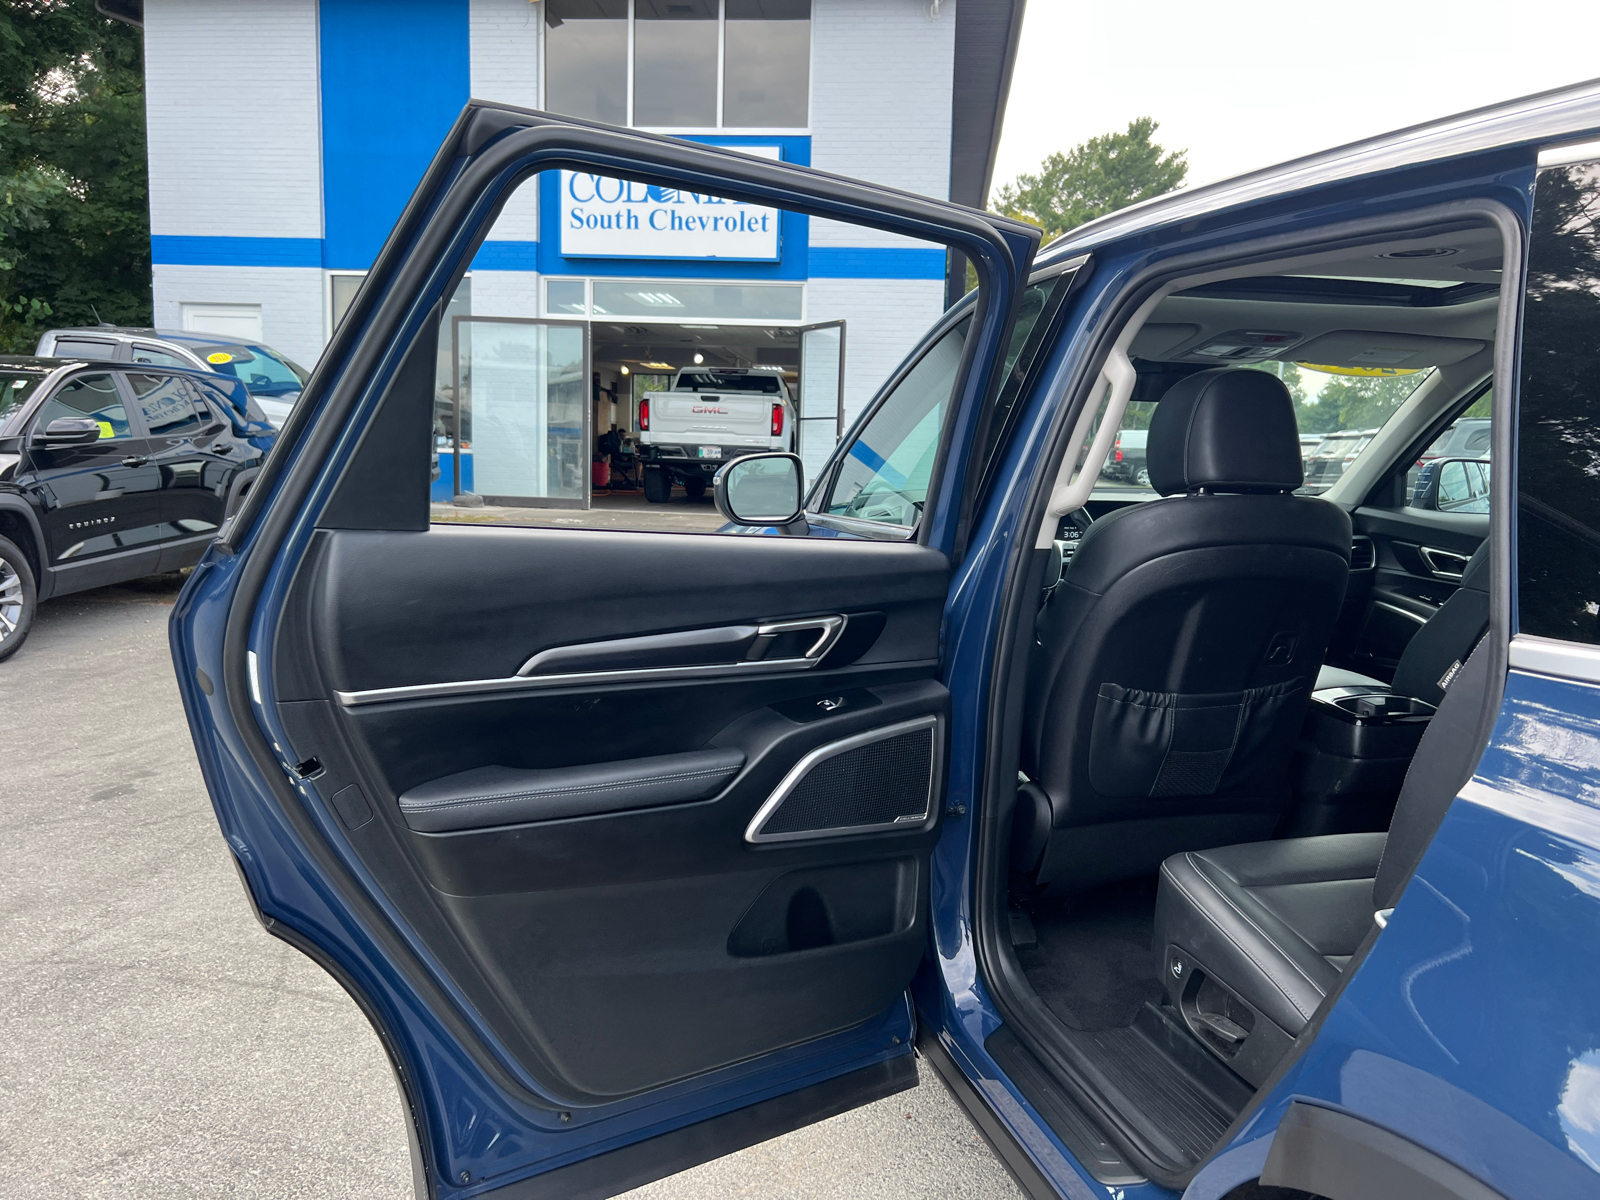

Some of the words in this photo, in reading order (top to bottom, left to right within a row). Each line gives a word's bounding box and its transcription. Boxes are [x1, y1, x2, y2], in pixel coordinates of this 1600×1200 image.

[570, 207, 640, 230] South
[649, 208, 770, 233] Chevrolet
[692, 406, 729, 415] GMC
[68, 516, 116, 530] EQUINOX
[1441, 662, 1460, 689] AIRBAG
